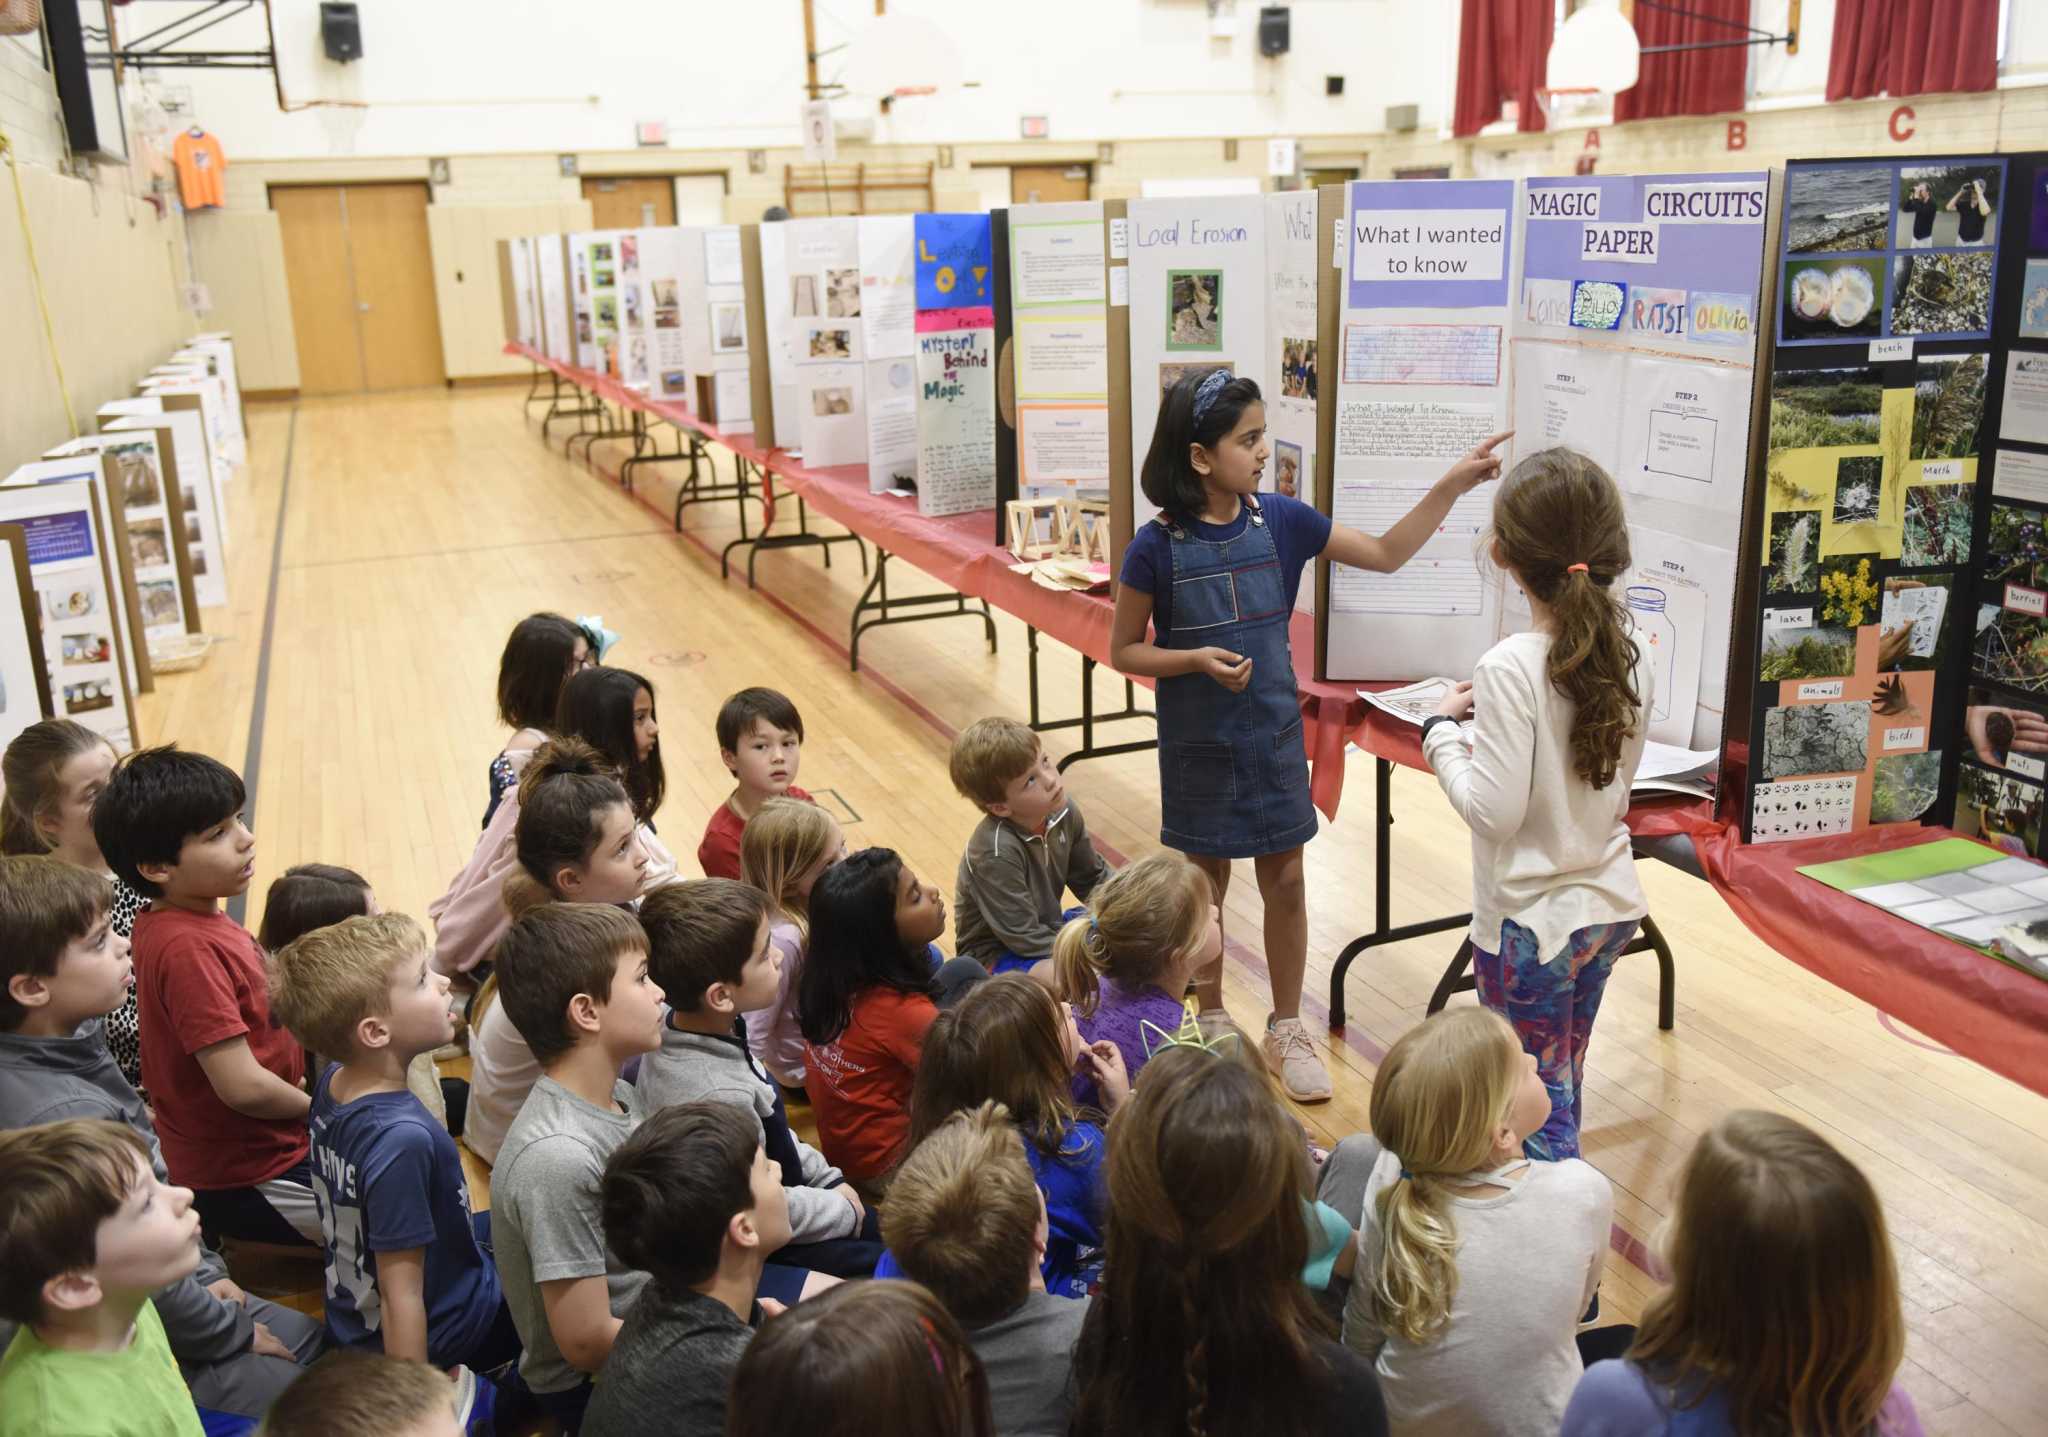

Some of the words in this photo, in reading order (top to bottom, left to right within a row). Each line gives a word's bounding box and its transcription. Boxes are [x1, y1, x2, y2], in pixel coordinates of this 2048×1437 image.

[1889, 107, 1916, 141] C
[1584, 129, 1600, 149] A
[1727, 121, 1747, 150] B
[1529, 193, 1597, 216] MAGIC
[1647, 191, 1763, 218] CIRCUITS
[1136, 220, 1180, 248] Local
[1191, 219, 1248, 245] Erosion
[1357, 225, 1411, 243] What
[1416, 226, 1421, 243] I
[1427, 225, 1502, 243] wanted
[1584, 229, 1654, 255] PAPER
[1387, 257, 1408, 274] to
[1414, 256, 1468, 274] know
[1877, 342, 1903, 354] beach
[923, 380, 966, 402] Magic
[1675, 391, 1692, 400] STEP
[1779, 614, 1805, 625] lake
[1803, 685, 1840, 696] animals
[1888, 731, 1914, 743] birds
[829, 1052, 866, 1073] OTHERS
